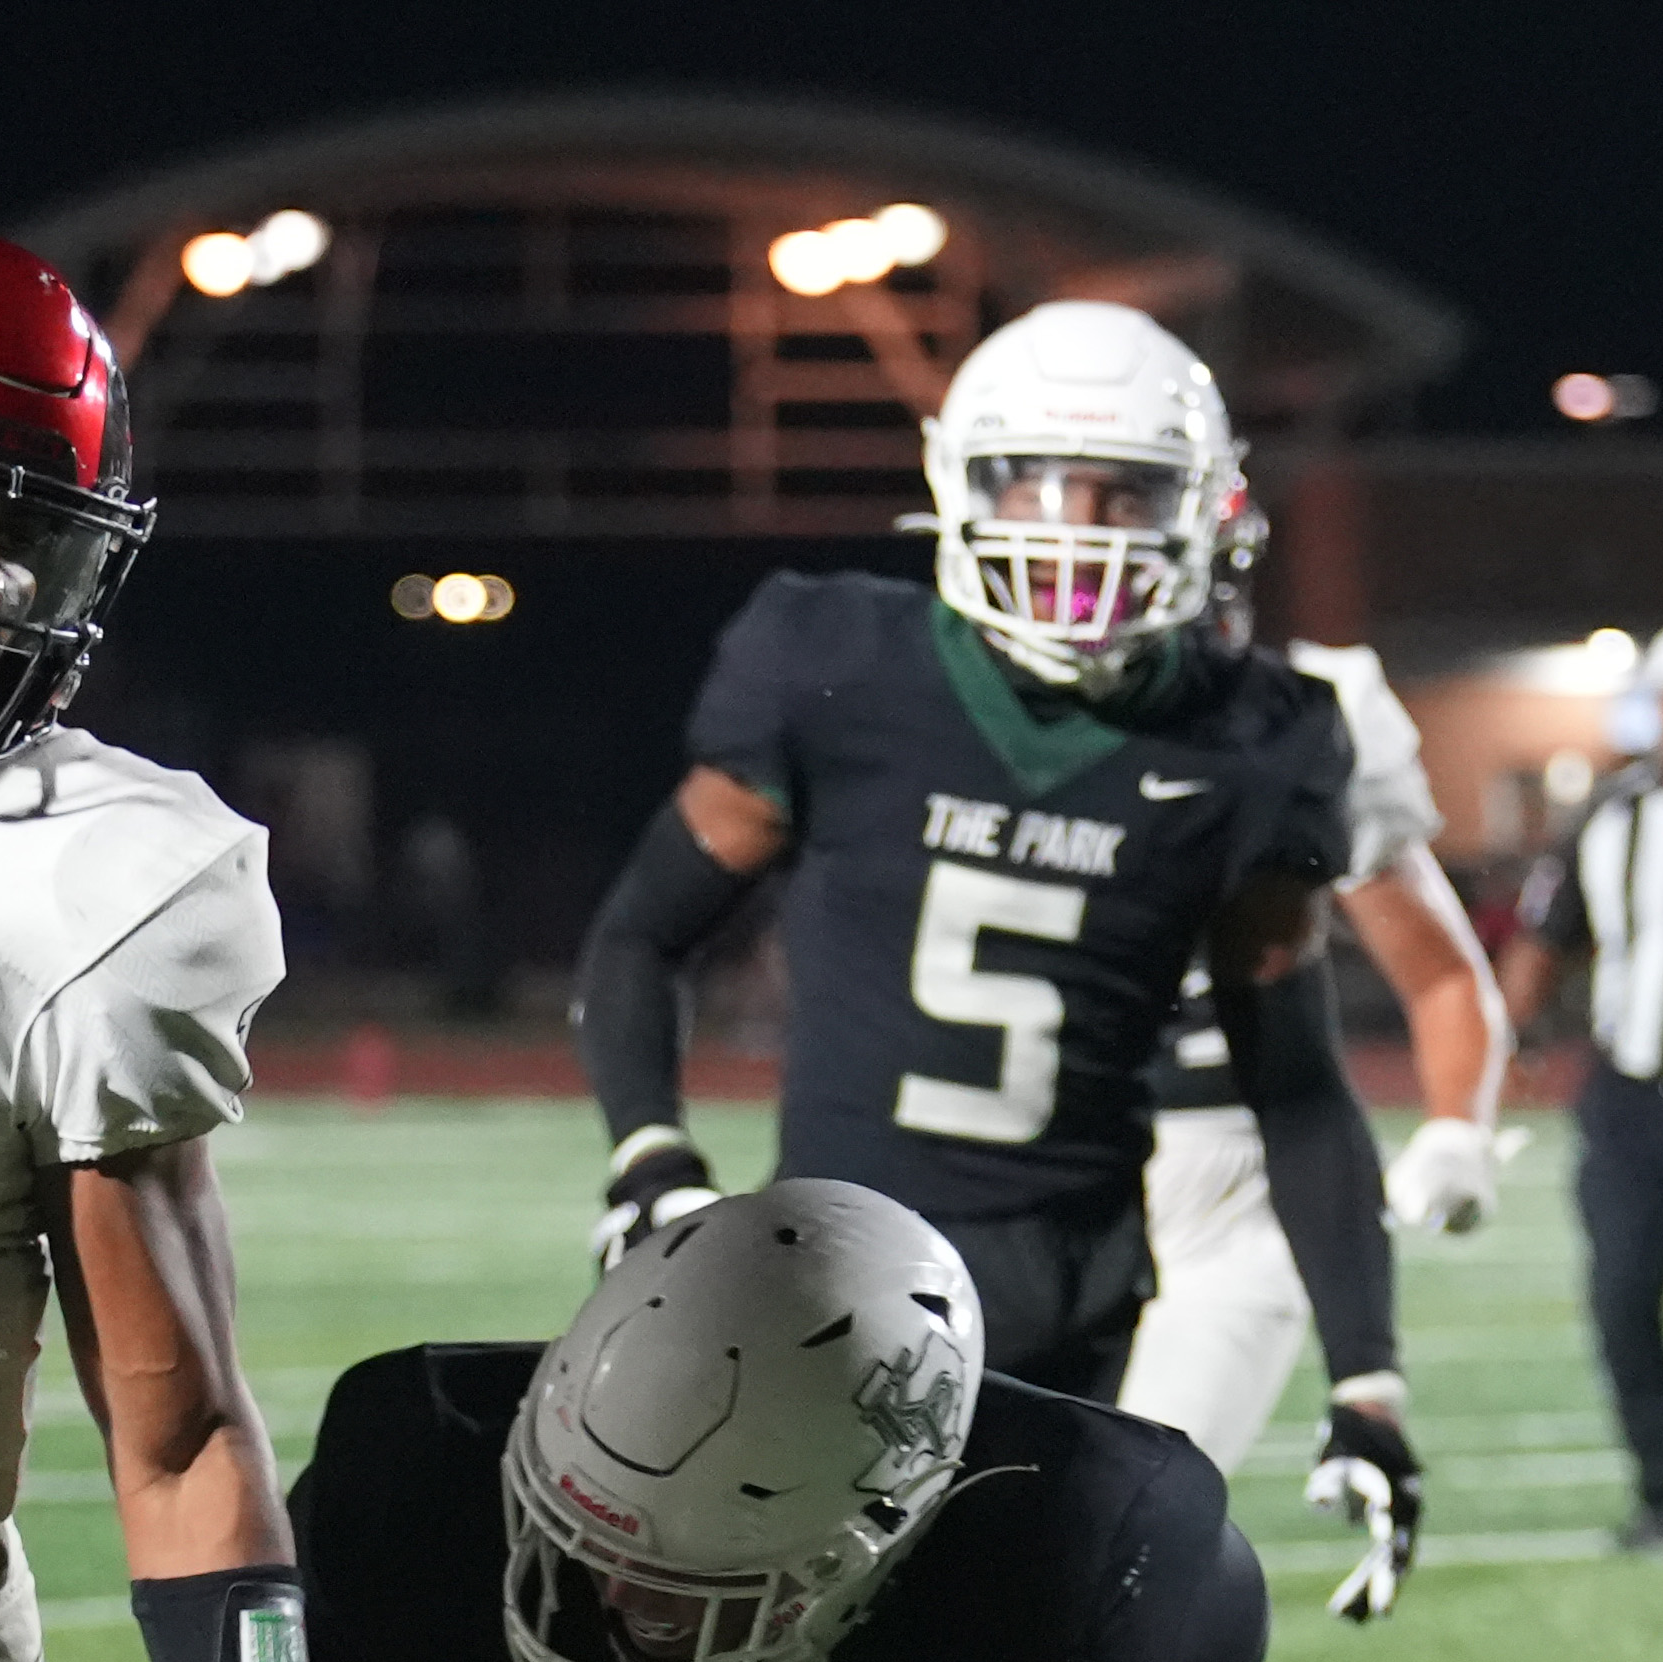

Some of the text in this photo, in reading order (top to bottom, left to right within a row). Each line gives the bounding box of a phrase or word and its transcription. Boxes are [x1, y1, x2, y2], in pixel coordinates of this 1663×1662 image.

[922, 793, 1127, 877] THE PARK
[894, 860, 1087, 1143] 5
